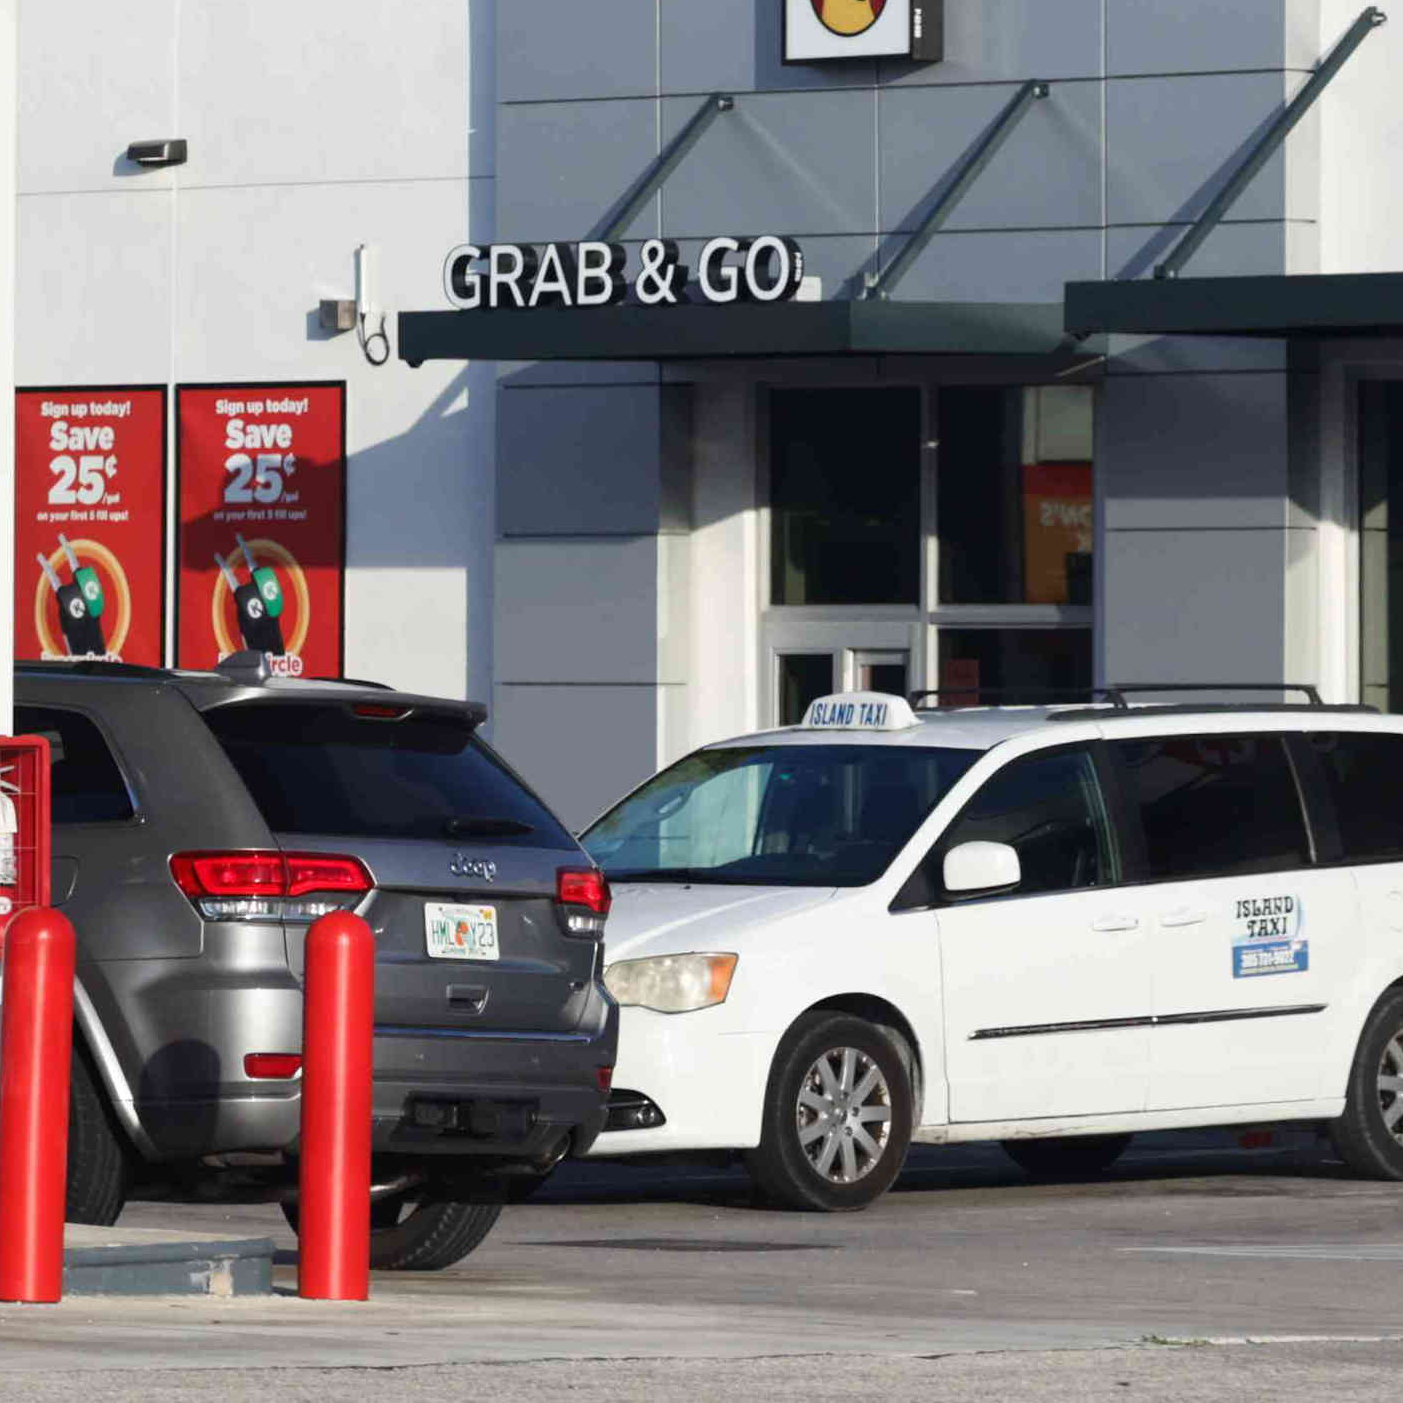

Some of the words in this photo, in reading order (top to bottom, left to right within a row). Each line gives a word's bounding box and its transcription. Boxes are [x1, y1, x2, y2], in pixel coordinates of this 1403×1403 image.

[444, 241, 616, 310] GRAB
[635, 239, 679, 305] &
[699, 235, 793, 303] GO
[41, 401, 69, 418] Sign
[71, 403, 87, 418] up
[89, 400, 131, 417] today!
[215, 399, 245, 417] Sign
[246, 401, 264, 416] up
[265, 397, 309, 416] today!
[49, 420, 115, 451] Save
[225, 418, 292, 449] Save
[809, 702, 855, 726] ISLAND
[859, 702, 889, 727] TAXI
[450, 852, 497, 883] Jeep
[1236, 896, 1294, 919] ISLAND
[1247, 917, 1287, 938] TAXI
